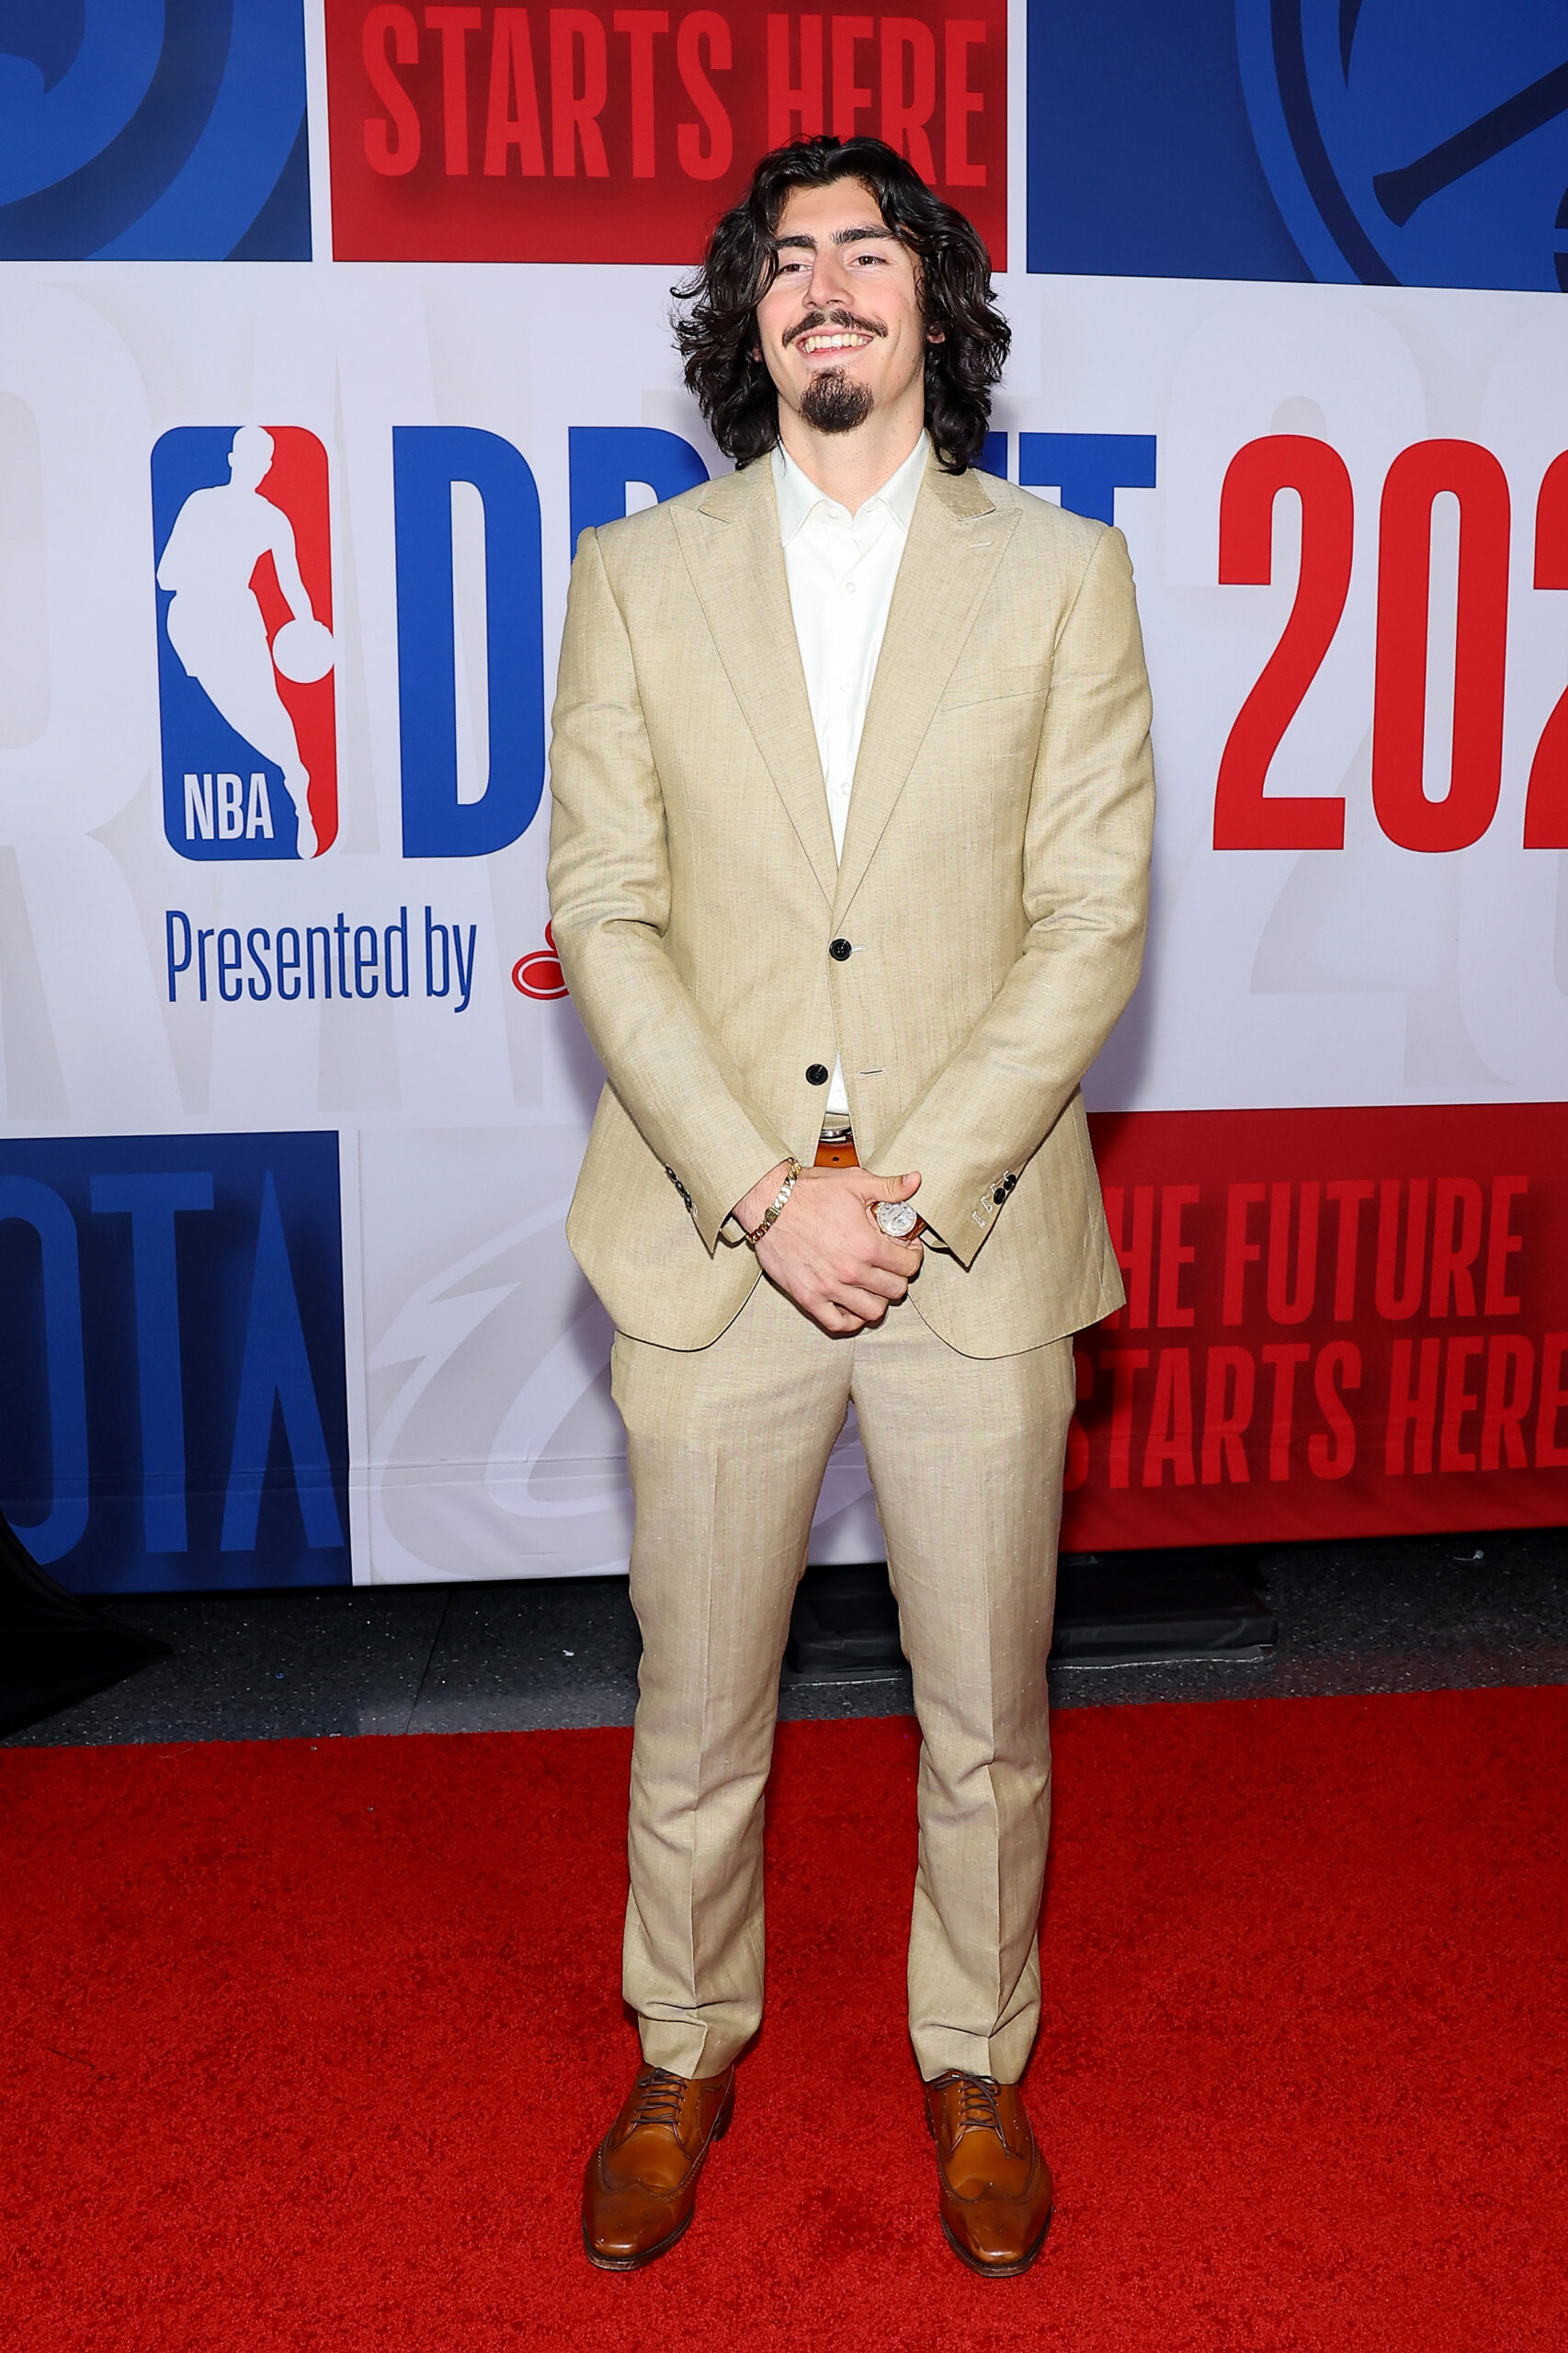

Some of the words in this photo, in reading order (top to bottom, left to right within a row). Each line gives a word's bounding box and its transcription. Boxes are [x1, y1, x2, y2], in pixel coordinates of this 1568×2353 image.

[362, 4, 734, 181] STARTS
[767, 13, 986, 187] HERE
[183, 772, 275, 841] NBA
[165, 905, 410, 1003] Presented
[424, 905, 478, 1013] by
[1100, 1184, 1200, 1330] HE
[1221, 1175, 1529, 1327] FUTURE
[1384, 1331, 1568, 1475] HERE
